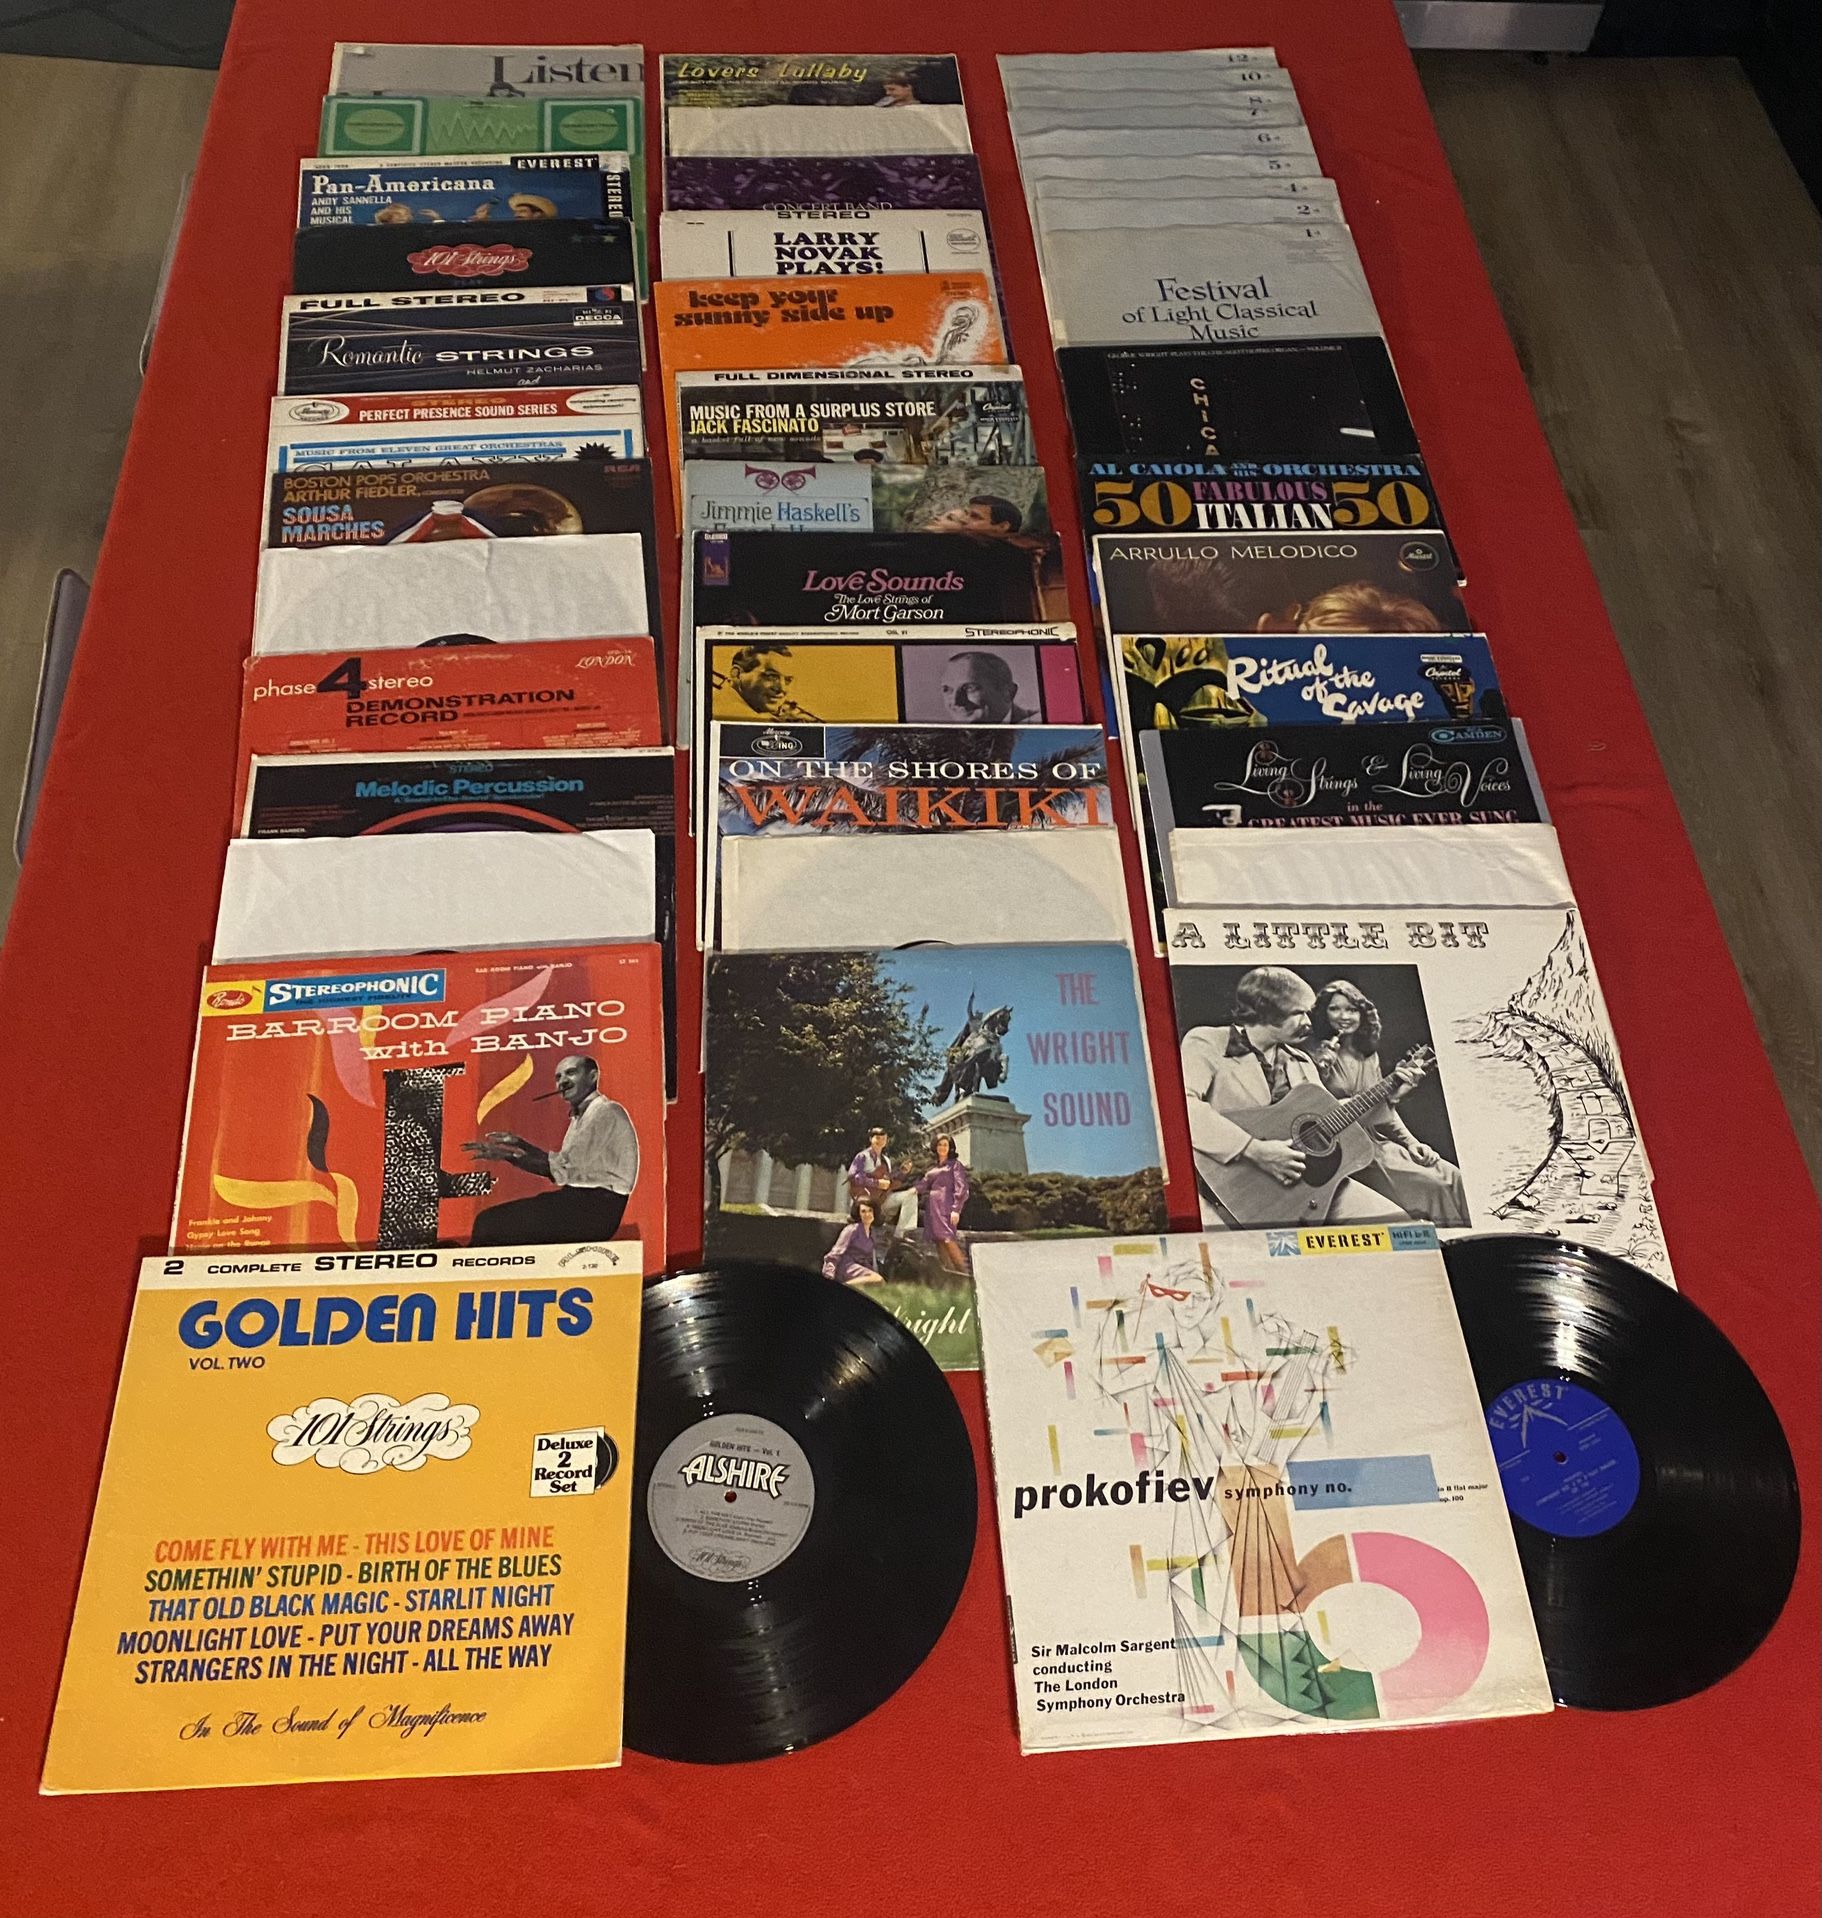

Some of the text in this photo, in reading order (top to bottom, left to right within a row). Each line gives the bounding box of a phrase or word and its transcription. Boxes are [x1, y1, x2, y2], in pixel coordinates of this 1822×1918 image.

[485, 54, 643, 85] Listen
[678, 62, 868, 82] Lovers Lullaby
[517, 157, 594, 169] EVEREST
[311, 173, 496, 195] Pan-Americana
[311, 195, 393, 206] ANDY SANNELLA
[606, 174, 624, 218] STEREO
[310, 205, 352, 215] AND HIS
[777, 210, 871, 219] STEREO
[774, 231, 880, 246] LARRY
[424, 251, 518, 270] 101 Strings
[775, 246, 884, 260] NOVAK
[776, 260, 884, 275] PLAYS!
[688, 288, 839, 310] keep your
[1155, 275, 1272, 303] Festival
[300, 297, 381, 311] FULL
[391, 291, 526, 306] STEREO
[575, 312, 622, 321] DECCA
[674, 303, 894, 328] sunny side up
[1122, 299, 1320, 326] of Light Classical
[1190, 323, 1260, 343] Music
[309, 334, 595, 368] Romantic STRINGS
[466, 364, 604, 376] HELMUT ZACHARIAS
[714, 369, 974, 381] FULL DIMENSIONAL STEREO
[359, 403, 558, 422] PERFECT PRESENCE SOUND SERIES
[689, 401, 937, 421] MUSIC FROM A SURPLUS STORE
[688, 417, 819, 435] JACK FASCINATO
[295, 441, 563, 457] MUSIC FROM ELEVEN GREAT ORCHESTRAS
[284, 469, 490, 490] BOSTON POPS ORCHESTRA
[1089, 463, 1421, 477] AL CAIOLA ORCHESTRA
[284, 488, 351, 502] ARTHUR
[356, 485, 421, 499] FIEDLER,
[1193, 481, 1328, 502] FABULOUS
[701, 501, 861, 524] Jimmie Haskell's
[1092, 480, 1193, 528] 50
[1332, 480, 1430, 527] 50
[282, 504, 354, 524] SOUSA
[1196, 503, 1335, 530] ITALIAN
[281, 520, 385, 544] MARCHES
[1109, 545, 1358, 561] ARRULLO MELODICO
[803, 568, 965, 593] Love Sounds
[834, 593, 934, 607] The Love Strings of
[824, 603, 945, 623] Mort Garson
[964, 627, 1060, 637] STEREOPHONIC
[575, 655, 635, 669] LONDON
[1226, 643, 1334, 700] Ritual
[253, 657, 433, 702] phase 4 stereo
[1301, 668, 1376, 703] of the
[346, 689, 575, 714] DEMONSTRATION
[1322, 692, 1425, 724] Savage
[346, 710, 459, 728] RECORD
[1430, 729, 1502, 743] CAMDEN
[728, 760, 1101, 781] ON THE SHORES OF
[356, 776, 584, 798] Melodic Percussion
[1362, 755, 1389, 777] &
[1441, 758, 1511, 807] Voices
[736, 786, 1109, 827] WAIKIKI
[1347, 800, 1383, 811] in the
[1172, 921, 1489, 949] A LITTLE BIT
[269, 973, 439, 1005] STEREOPHONIC
[1056, 972, 1097, 1005] THE
[226, 1000, 625, 1041] BARROOM PIANO
[360, 1027, 628, 1060] with BANJO
[1026, 1031, 1131, 1066] WRIGHT
[1043, 1092, 1132, 1127] SOUND
[188, 1214, 272, 1226] Frankie and Johnny
[186, 1228, 261, 1240] Gypsy Love Song
[1305, 1232, 1383, 1249] EVEREST
[163, 1253, 536, 1276] 2 COMPLETE STEREO RECORDS
[178, 1287, 594, 1350] GOLDEN HITS
[189, 1355, 265, 1371] VOL. TWO
[290, 1411, 455, 1453] 101 Strings
[537, 1437, 594, 1453] Deluxe
[557, 1452, 572, 1469] 2
[534, 1466, 593, 1482] Record
[678, 1453, 790, 1499] ALSHIRE
[549, 1478, 578, 1494] Set
[1014, 1470, 1354, 1519] prokofiev symphony no.
[1031, 1637, 1177, 1658] Sir Malcolm Sargent
[1032, 1660, 1113, 1676] conducting
[1034, 1677, 1118, 1694] The London
[1036, 1692, 1186, 1713] Symphony Orchestra
